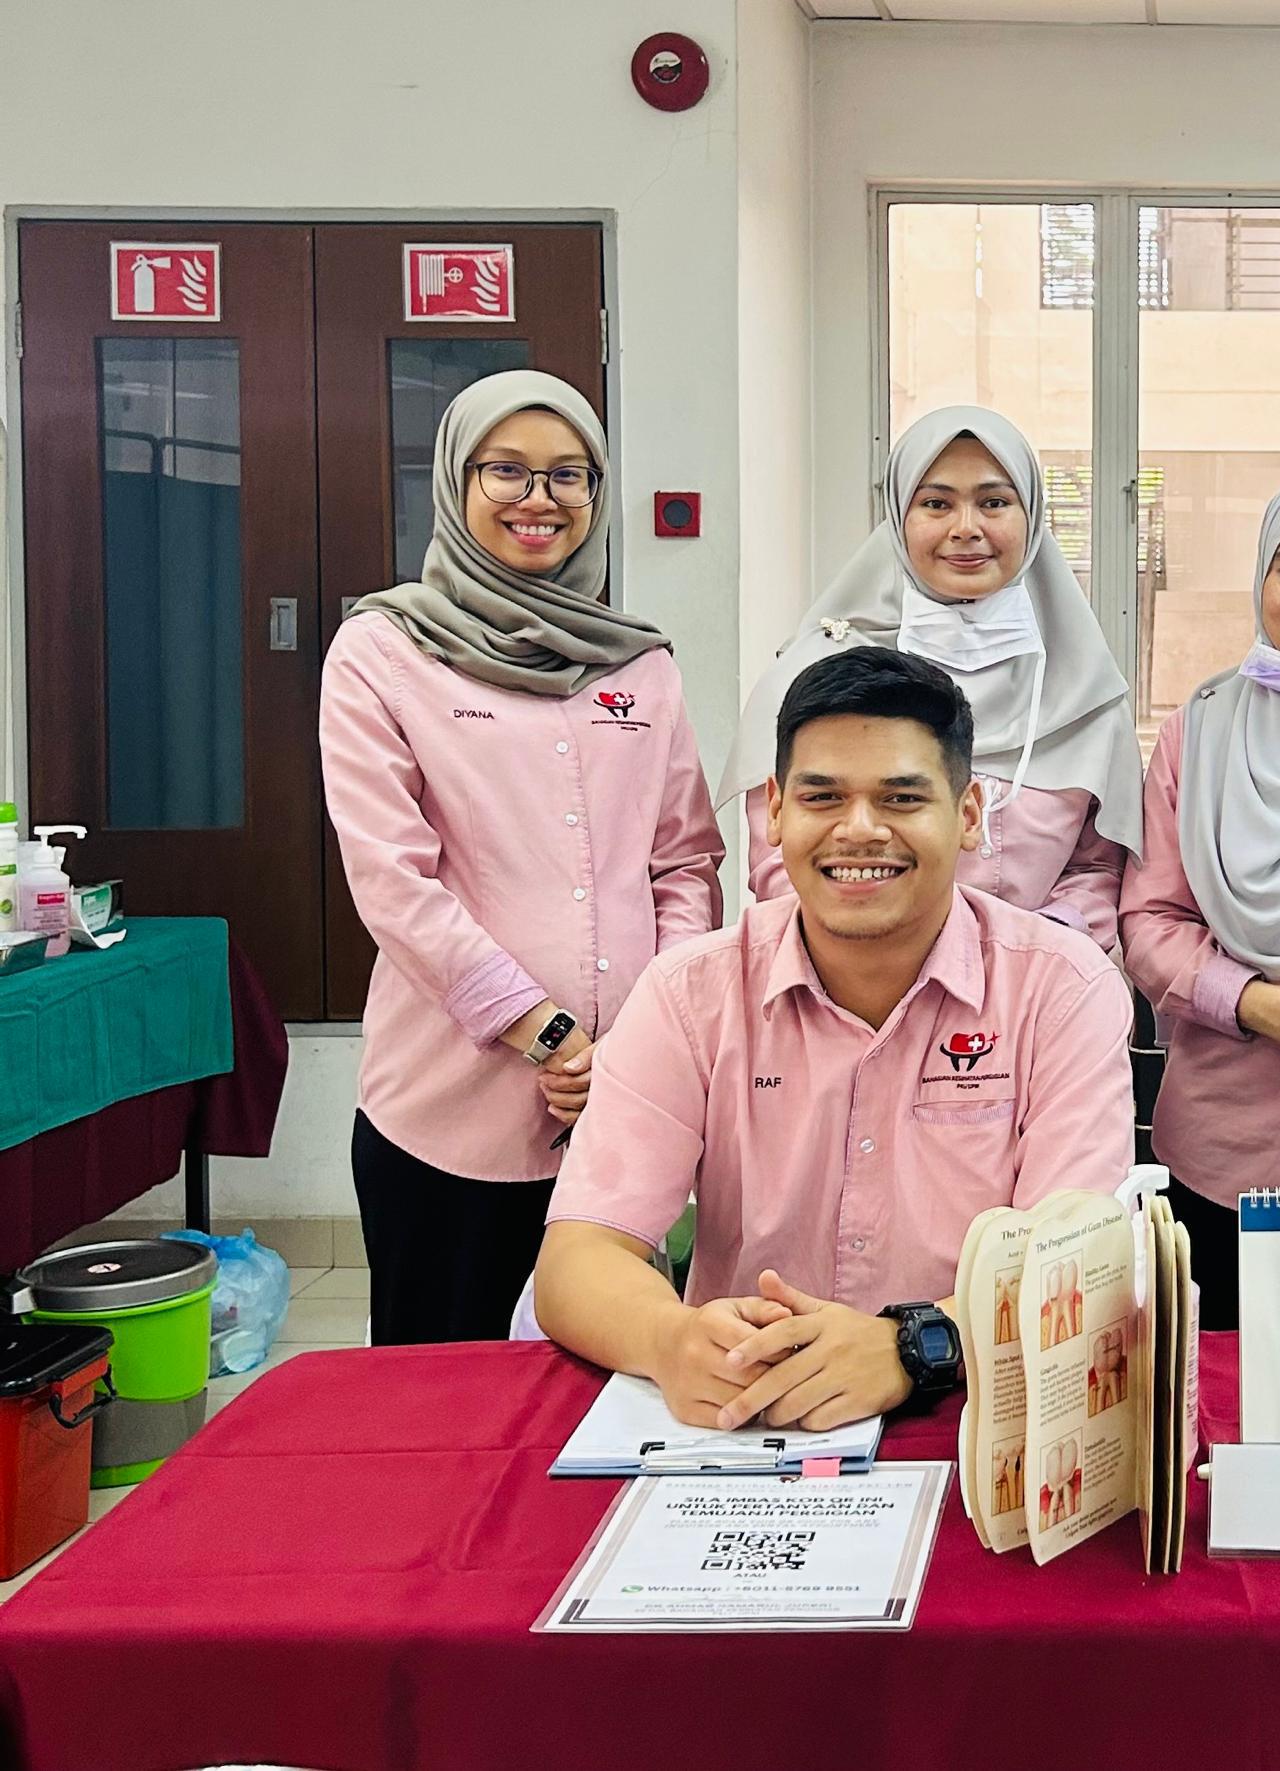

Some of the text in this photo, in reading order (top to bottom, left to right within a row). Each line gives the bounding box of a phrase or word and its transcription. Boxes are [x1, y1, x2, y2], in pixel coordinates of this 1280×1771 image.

[453, 708, 495, 720] DIYANA
[754, 1077, 782, 1089] RAF
[1001, 1230, 1017, 1241] The
[1036, 1242, 1048, 1254] The
[1081, 1224, 1088, 1236] of
[1088, 1221, 1102, 1233] Gum
[1102, 1213, 1124, 1229] Disease
